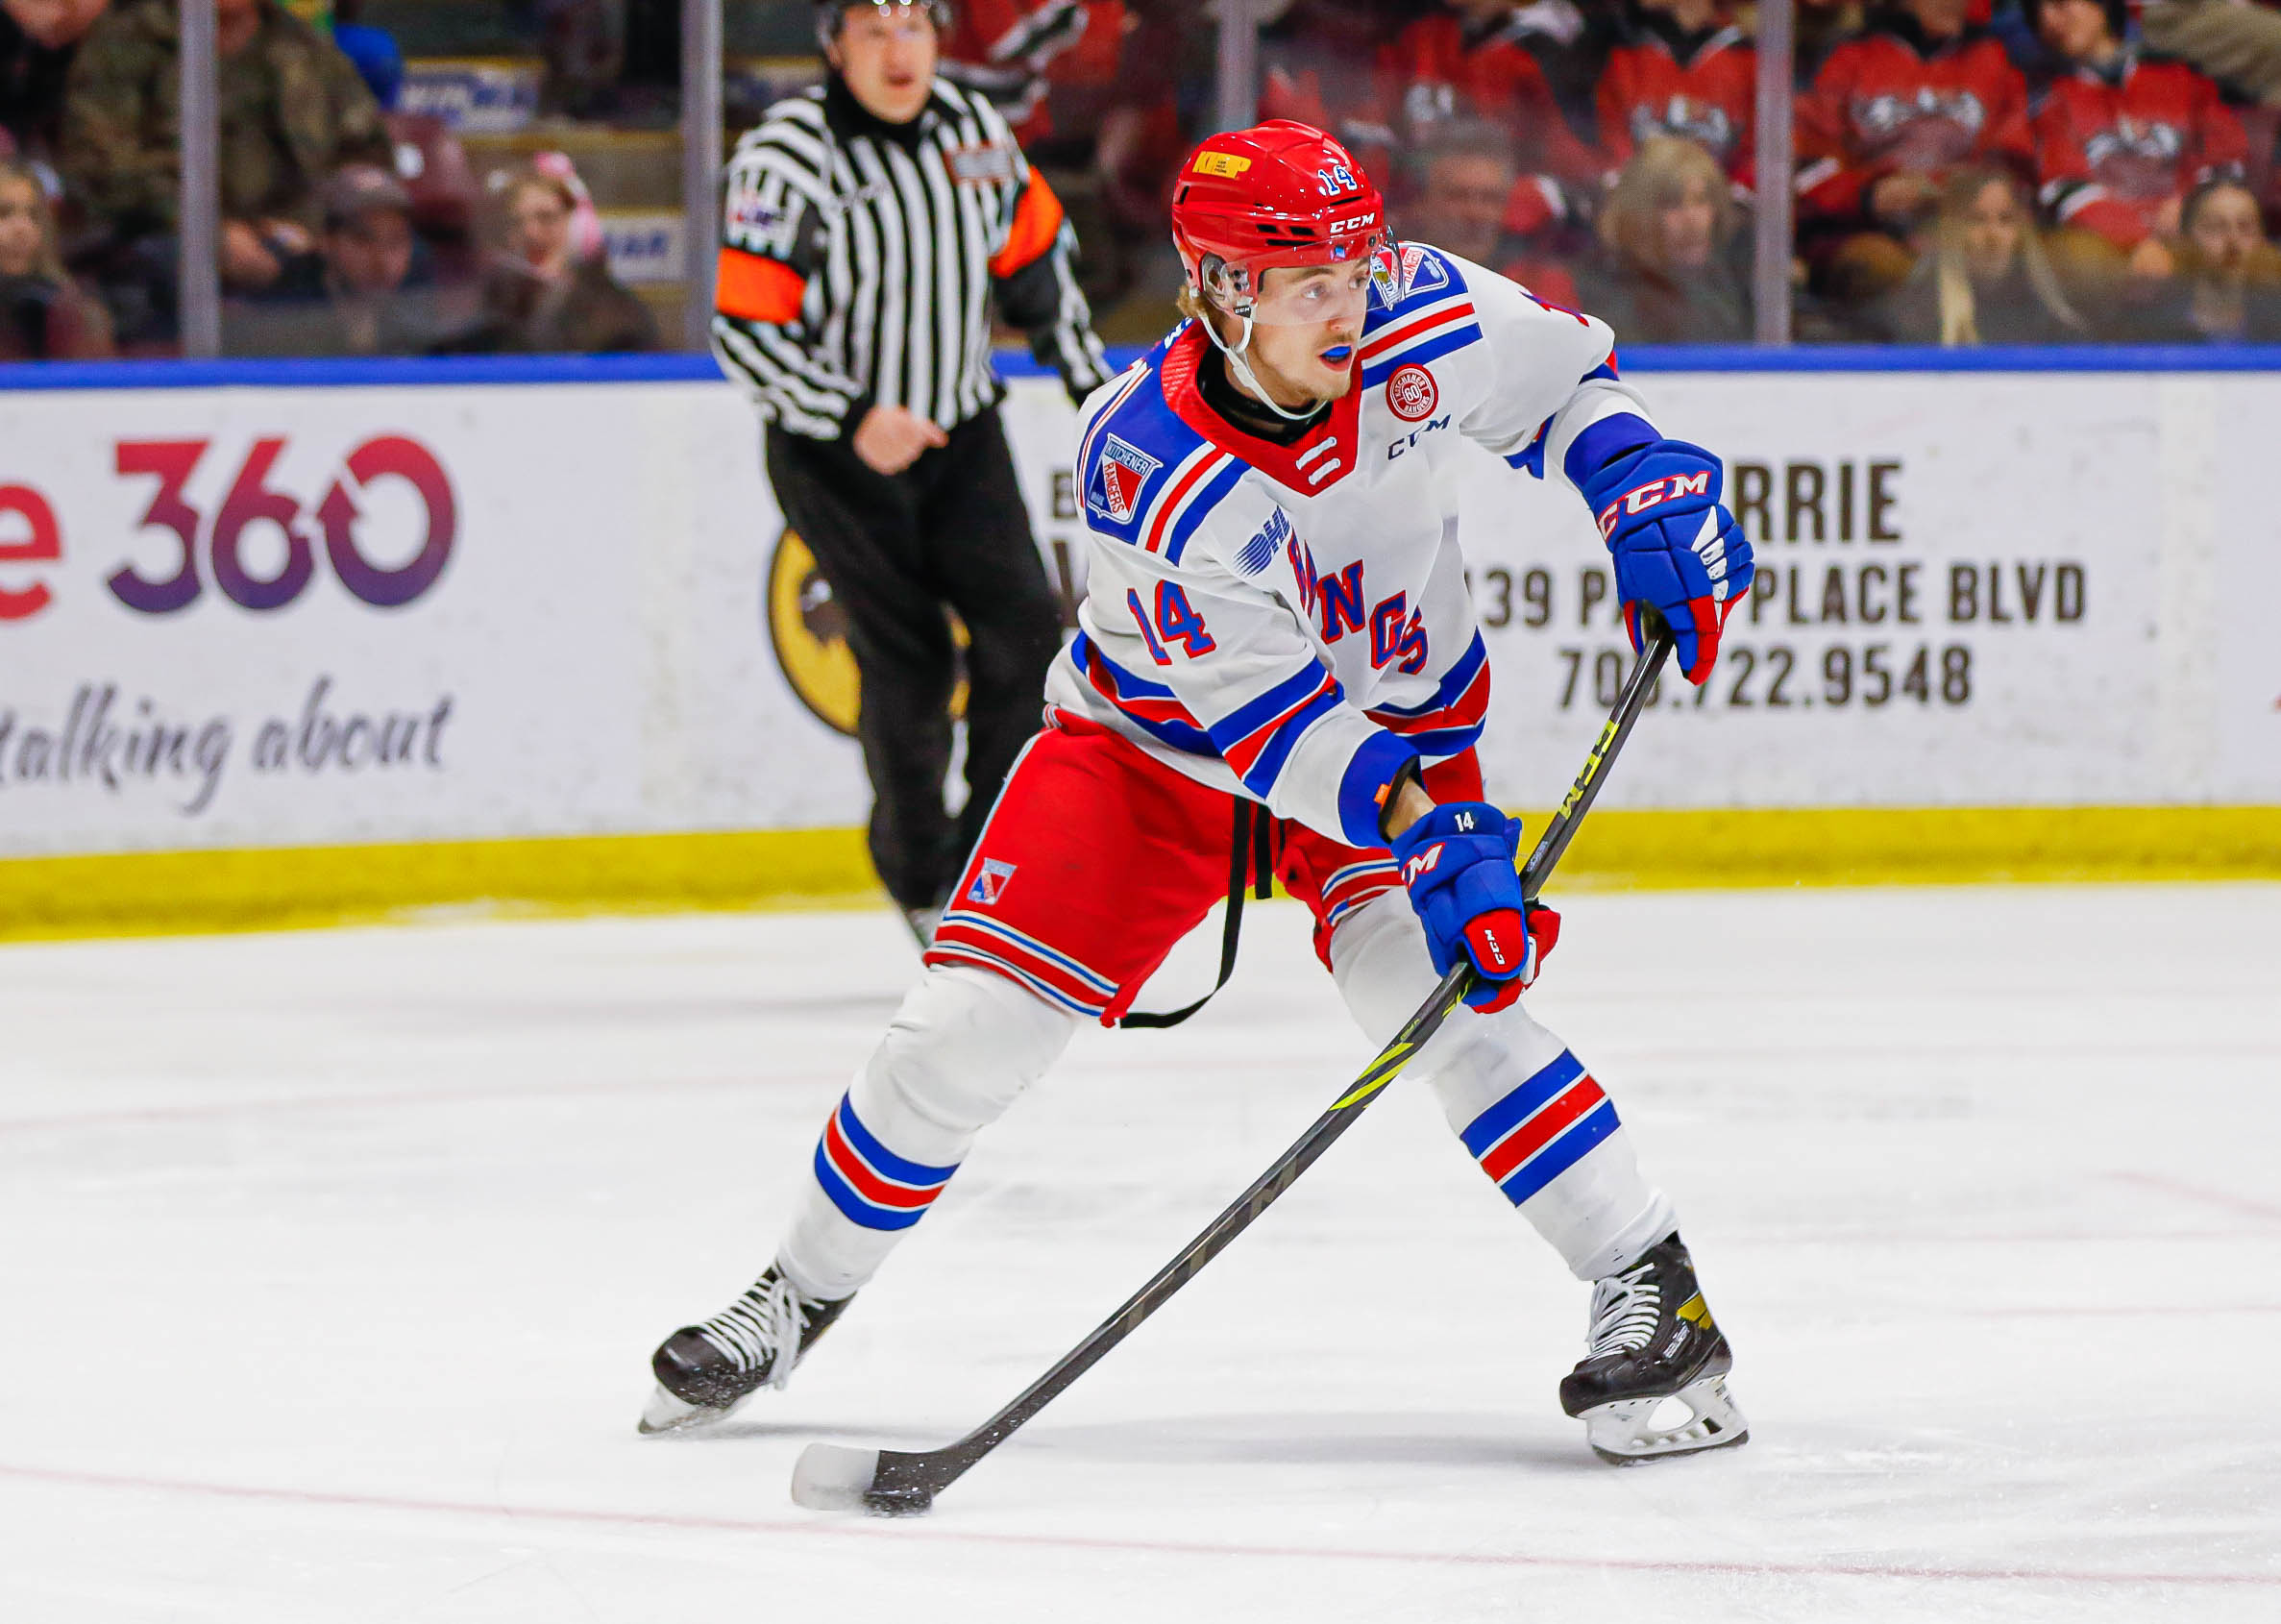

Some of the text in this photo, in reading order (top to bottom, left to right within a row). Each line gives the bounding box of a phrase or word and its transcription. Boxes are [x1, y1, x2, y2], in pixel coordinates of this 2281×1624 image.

[1317, 164, 1358, 196] 14
[1330, 212, 1375, 234] CCM
[1404, 384, 1420, 402] 60
[1104, 440, 1149, 475] KITCHENER
[1104, 461, 1125, 514] RANGERS
[1597, 470, 1710, 545] CCM
[1732, 463, 1902, 542] RRIE
[107, 434, 458, 613] 360
[1233, 504, 1290, 578] OHL
[1127, 578, 1216, 666] 14
[1749, 563, 1922, 625] PLACE
[1949, 562, 2087, 624] BLVD
[252, 673, 454, 771] about
[1455, 811, 1475, 833] 14
[1484, 929, 1506, 965] CCM
